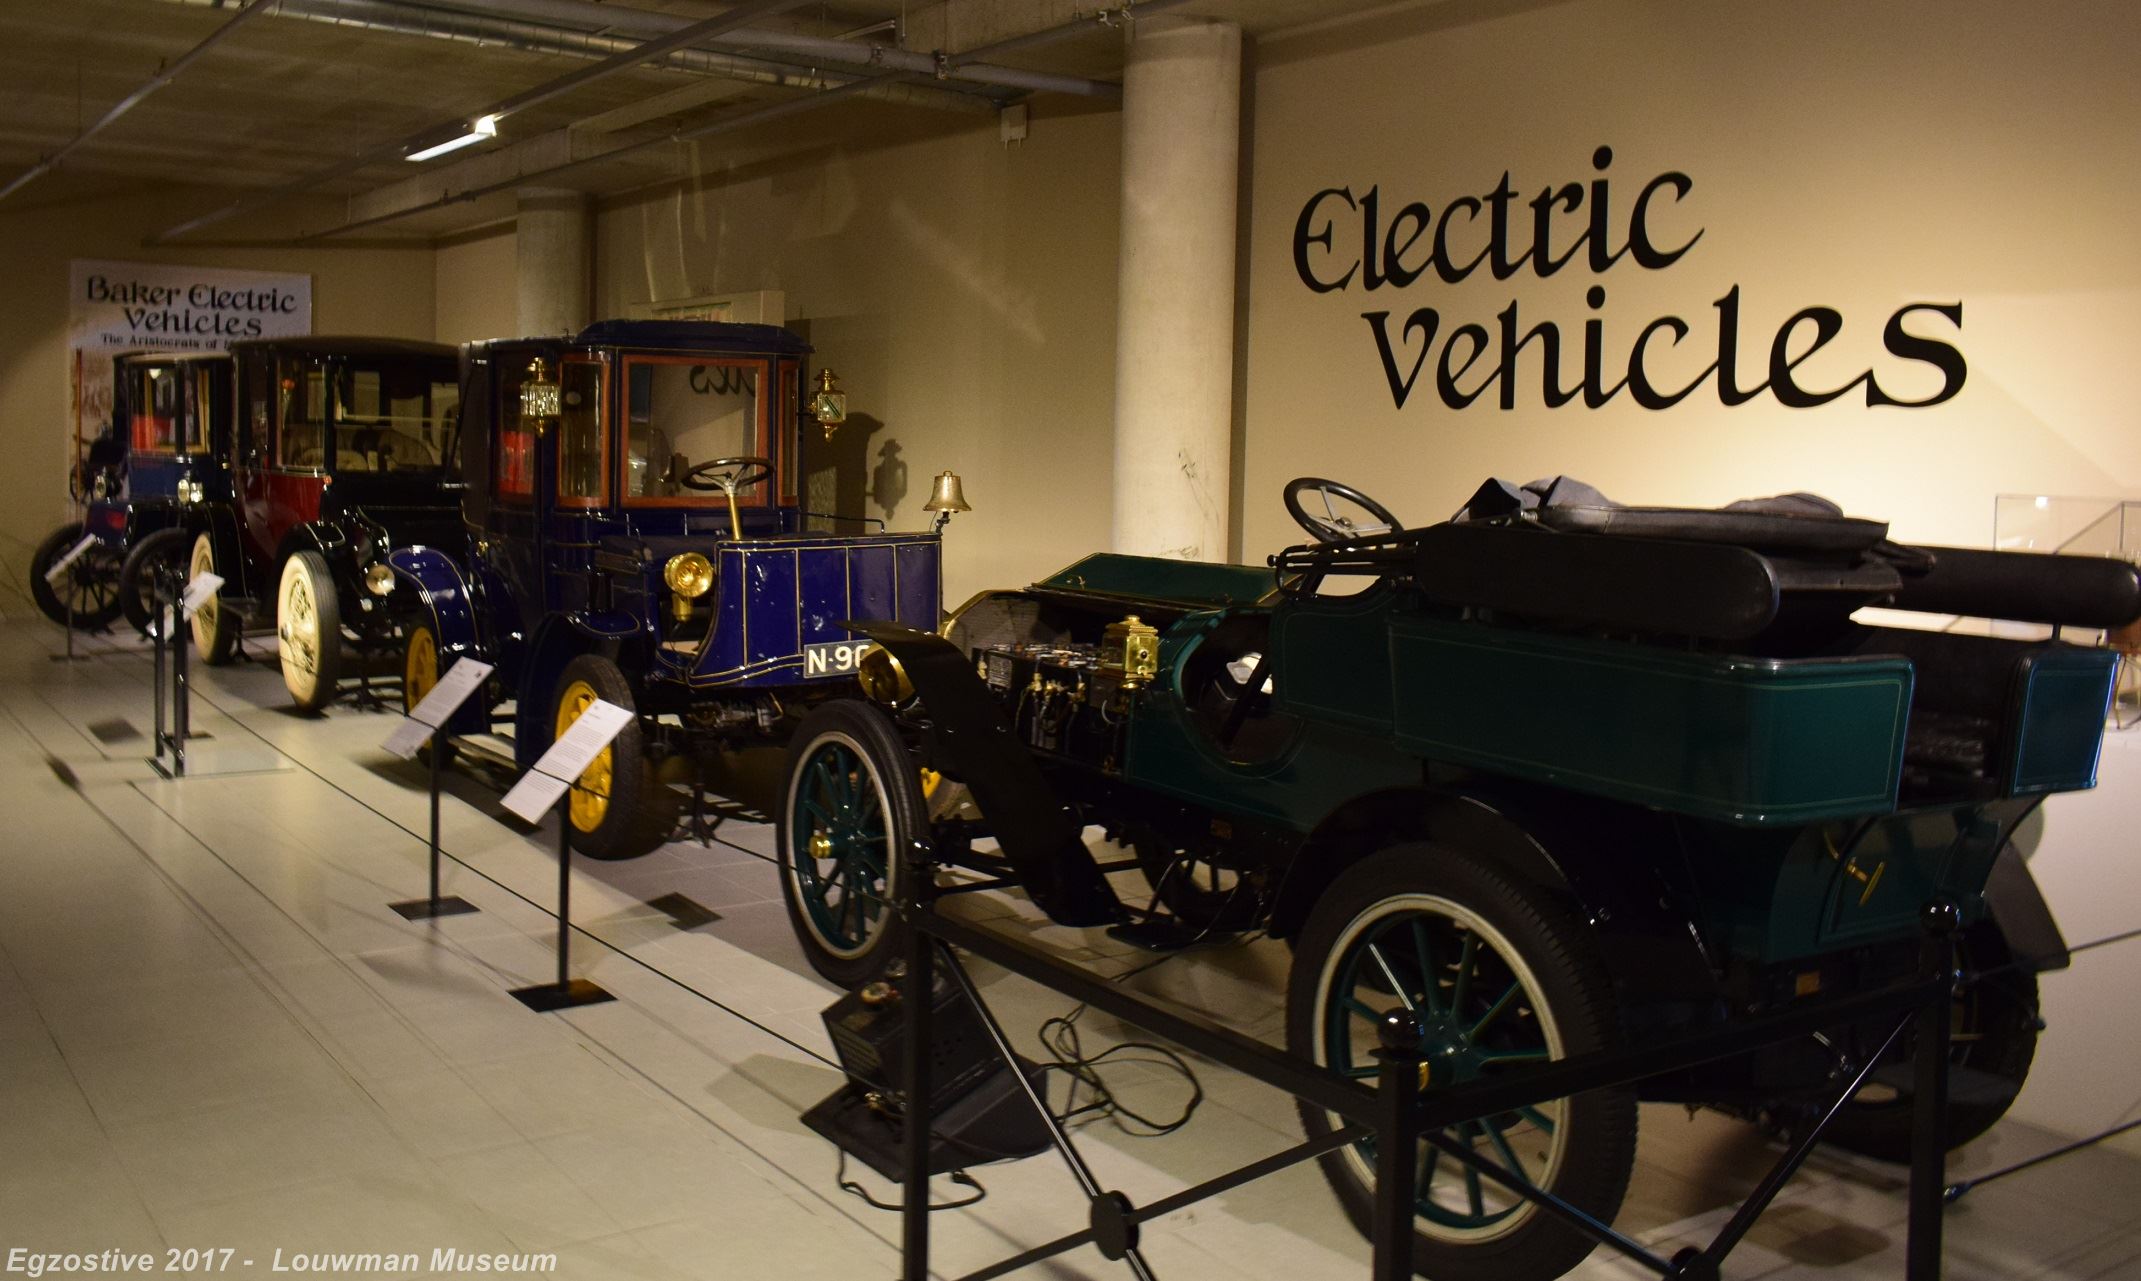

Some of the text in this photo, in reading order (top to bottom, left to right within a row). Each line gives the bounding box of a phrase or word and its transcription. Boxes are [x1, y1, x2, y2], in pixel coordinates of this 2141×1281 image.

[1293, 146, 1705, 293] Electric
[87, 275, 297, 314] Baker Electric
[124, 306, 263, 337] Vehicles
[101, 333, 123, 345] The
[129, 335, 200, 349] Aristocrats
[205, 341, 218, 350] of
[1360, 284, 1968, 410] Vehicles
